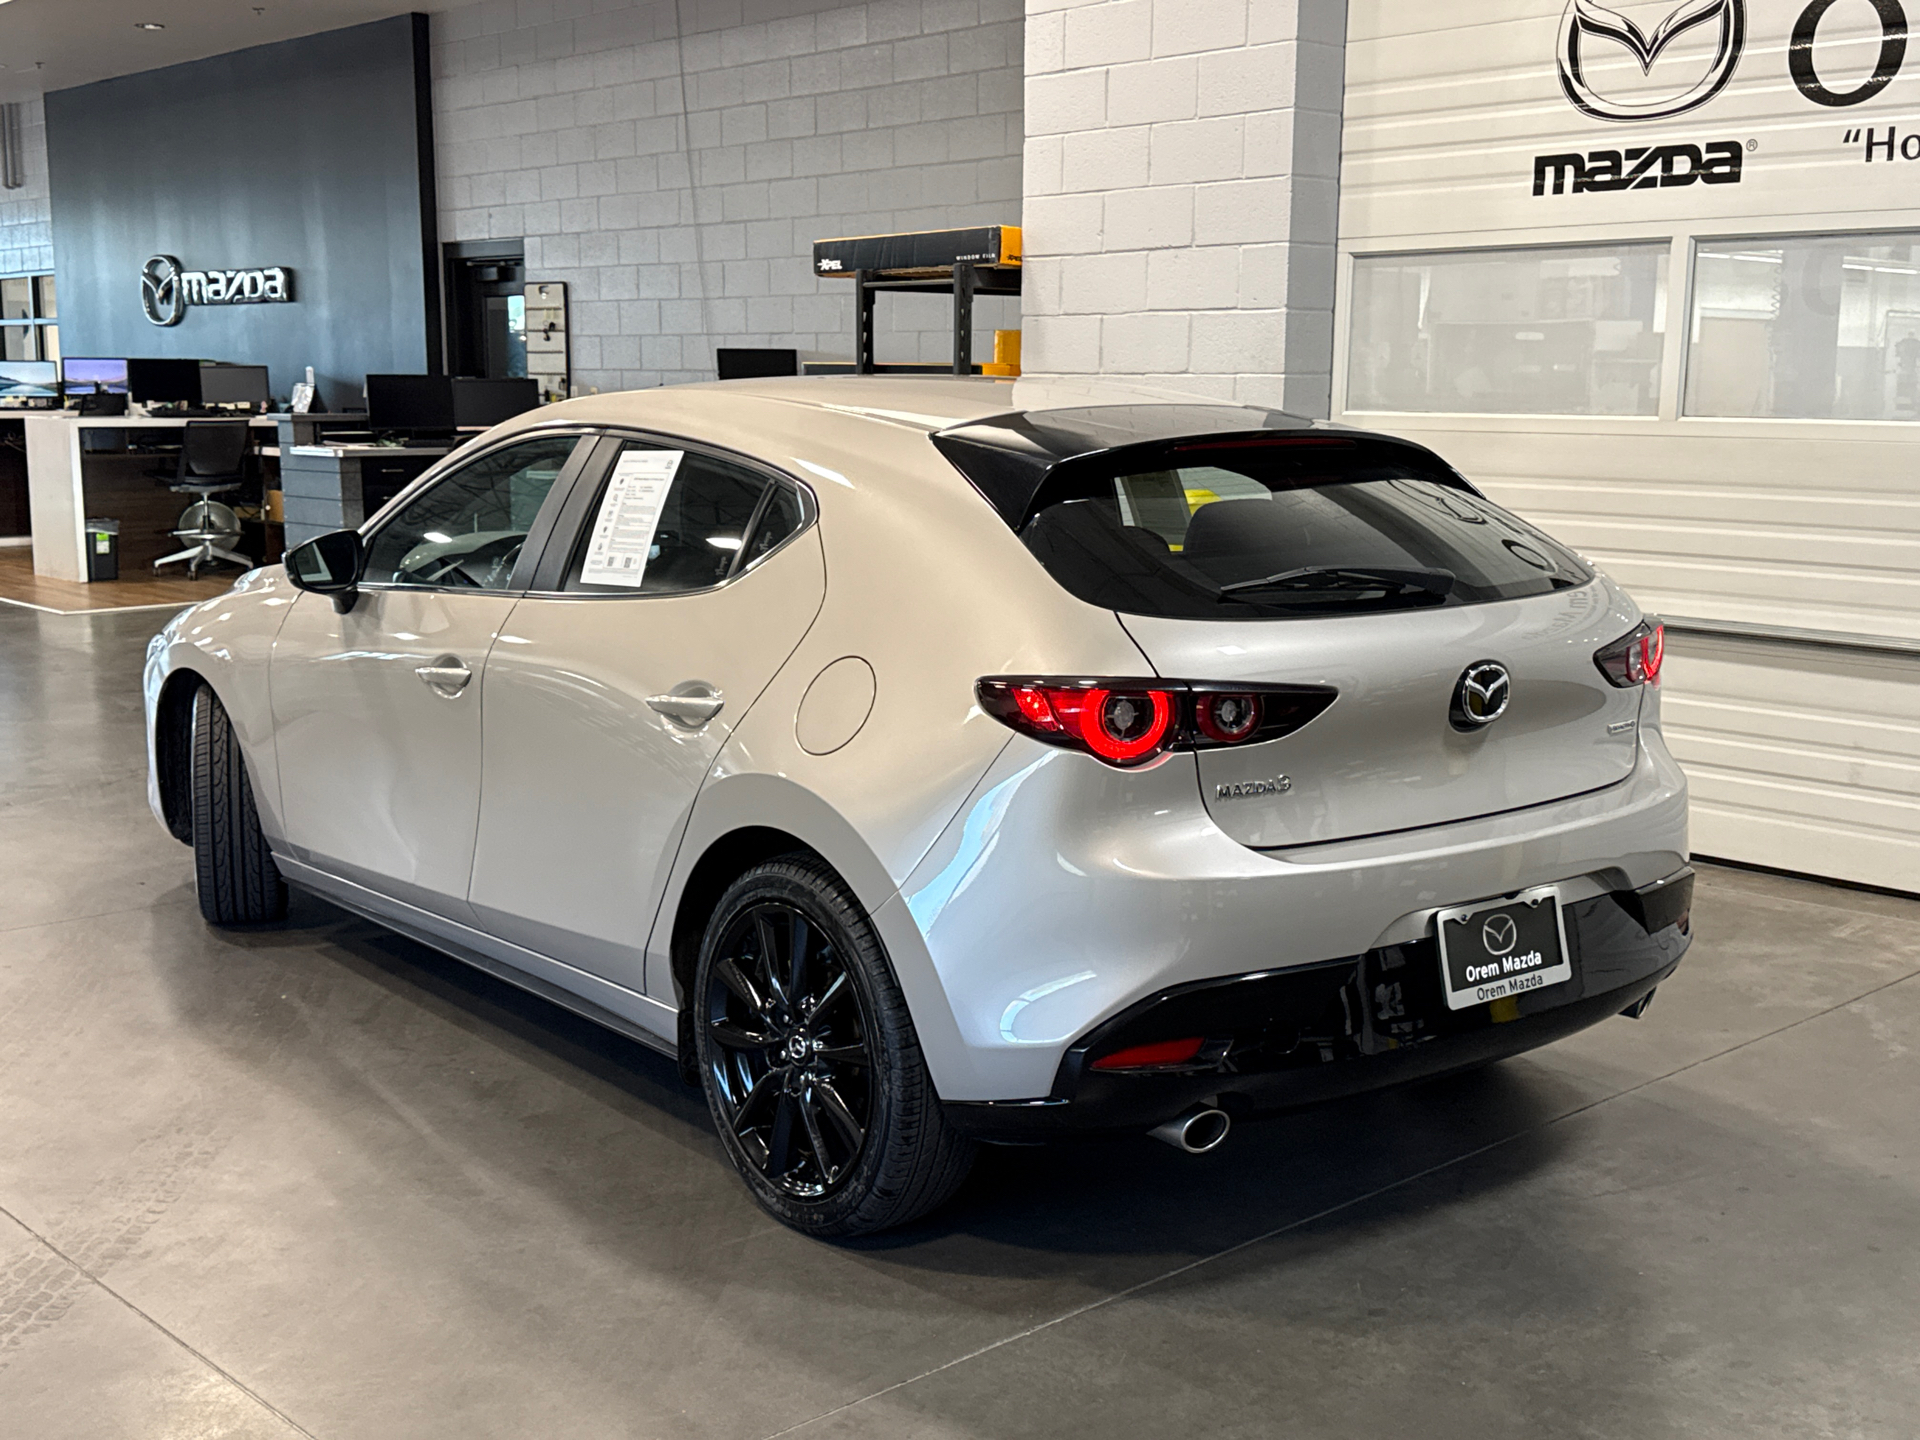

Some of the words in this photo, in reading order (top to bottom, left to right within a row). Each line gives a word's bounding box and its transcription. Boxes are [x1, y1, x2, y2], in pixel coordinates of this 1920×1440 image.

[817, 258, 843, 271] XPEL
[1215, 774, 1292, 801] MAZDA3
[1466, 962, 1499, 982] Orem
[1502, 950, 1542, 973] Mazda
[1477, 985, 1506, 1001] Orem
[1508, 974, 1543, 993] Mazda
